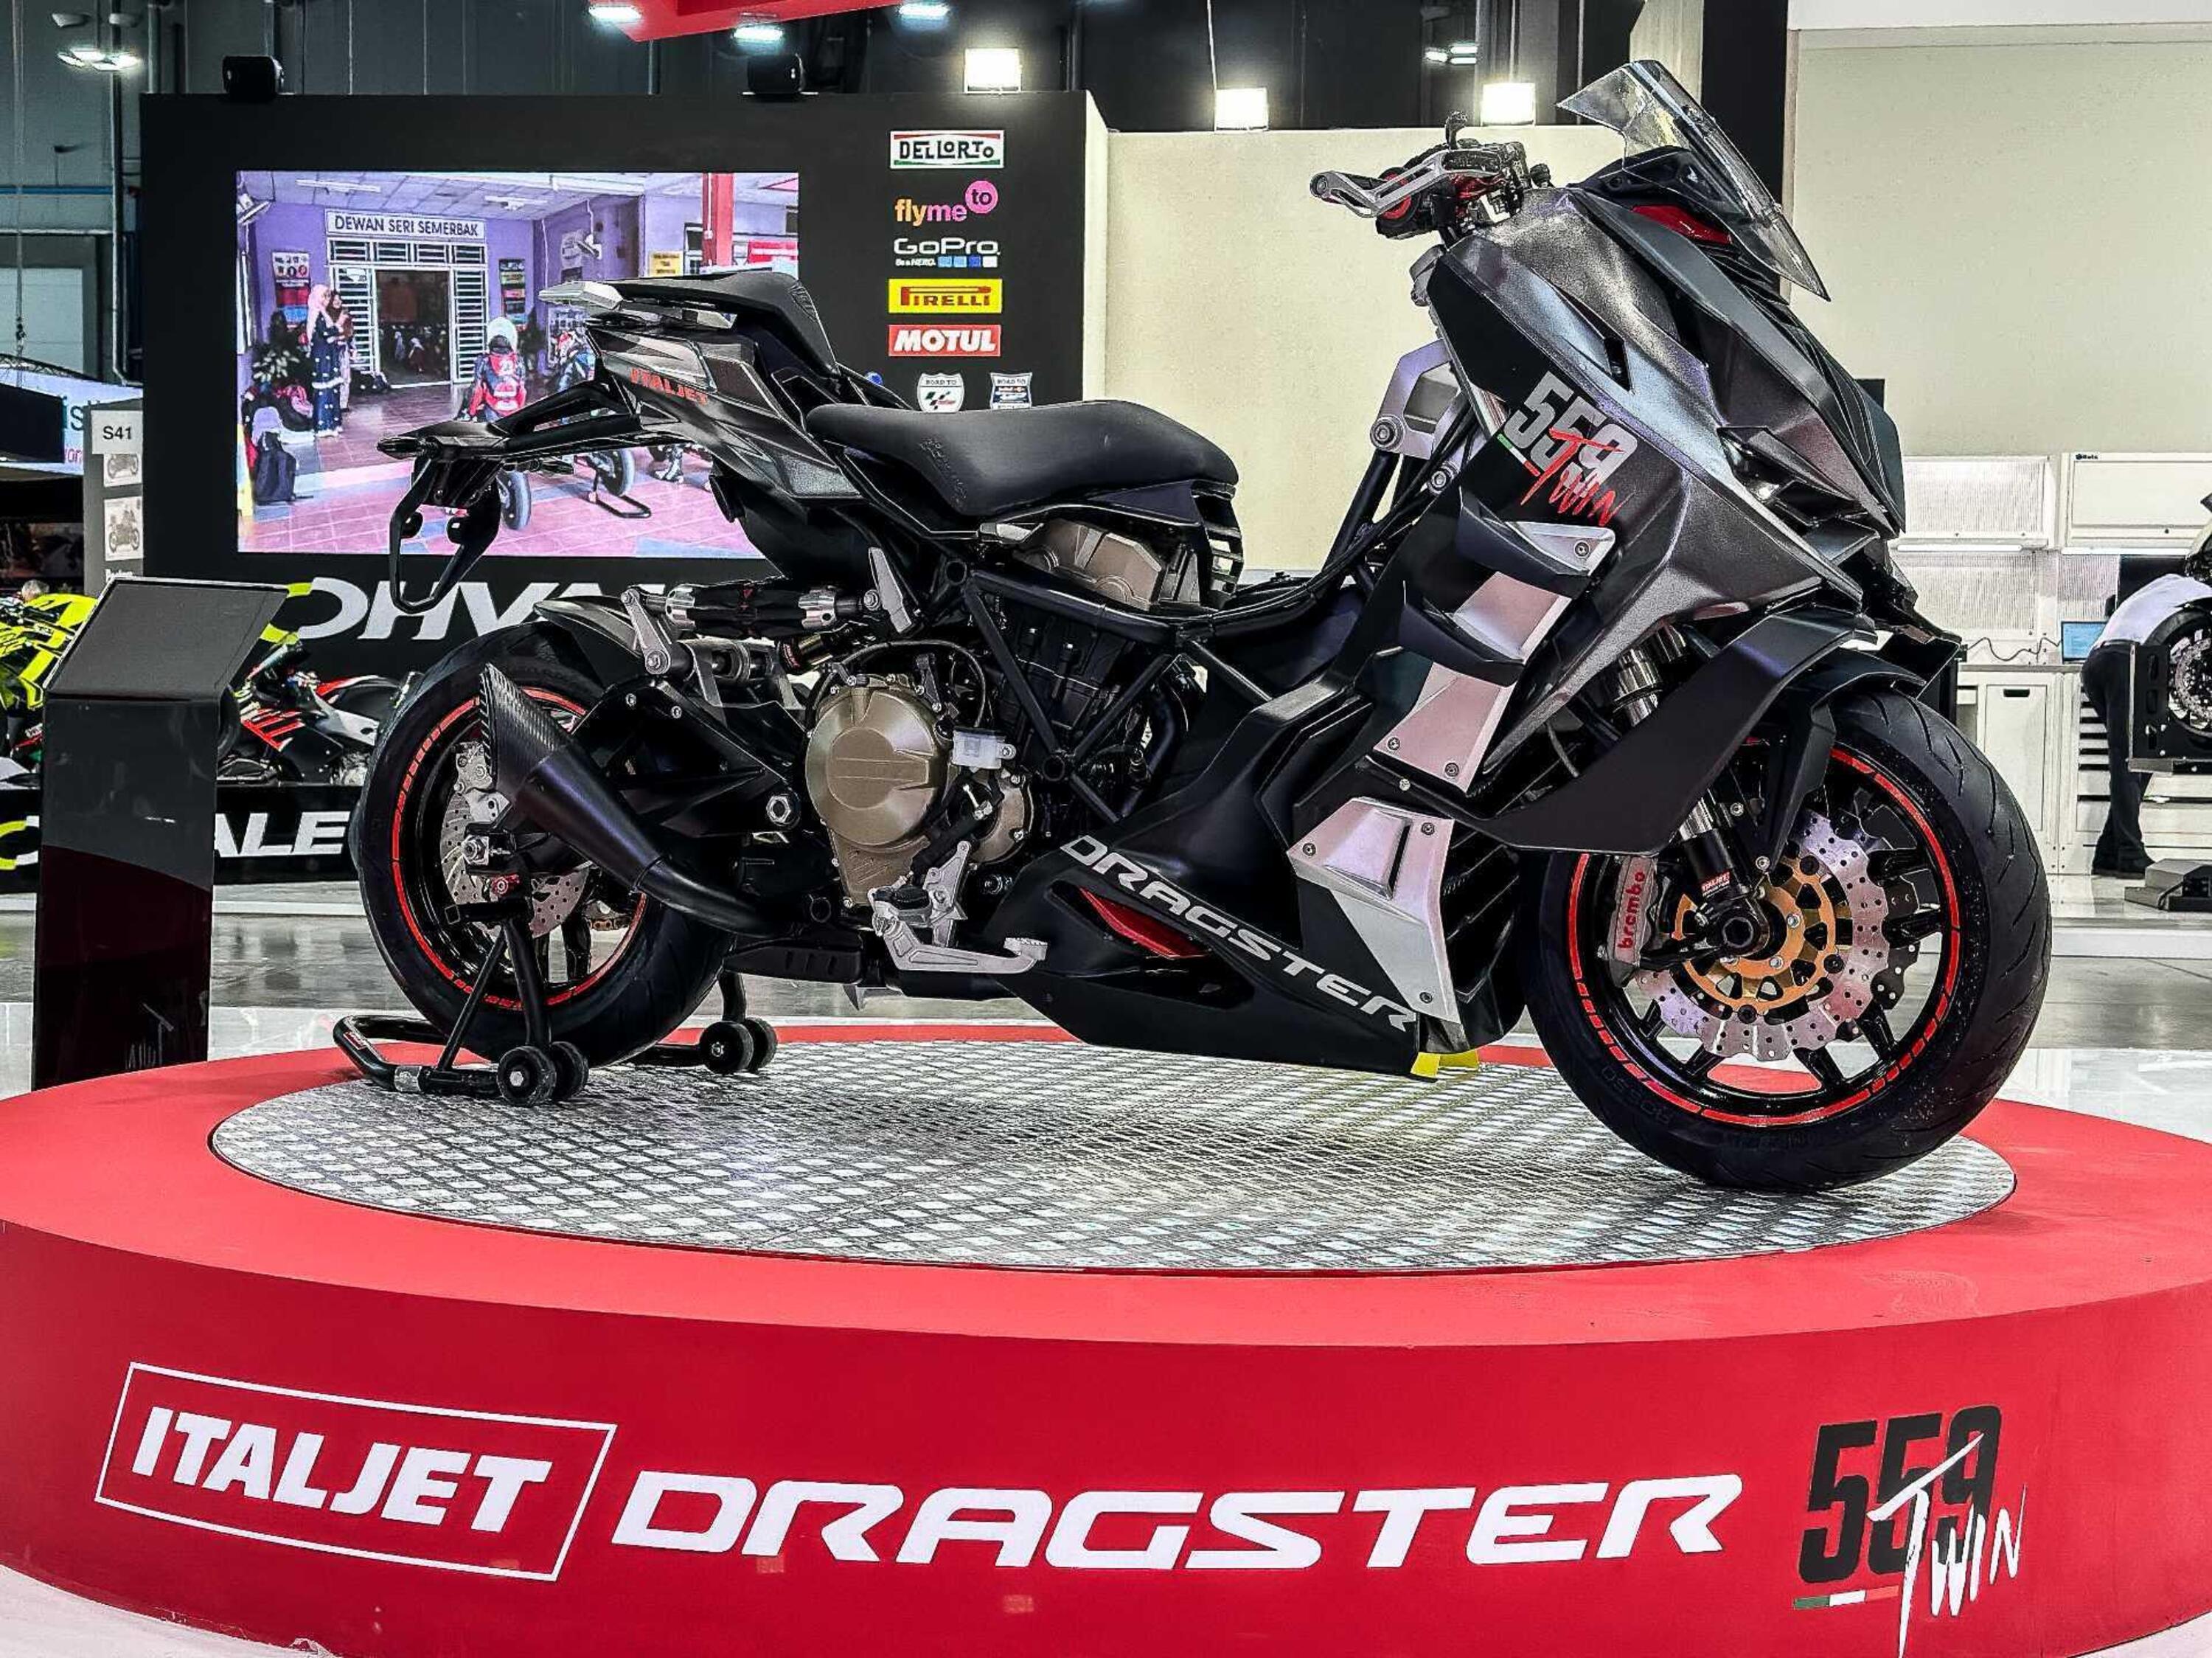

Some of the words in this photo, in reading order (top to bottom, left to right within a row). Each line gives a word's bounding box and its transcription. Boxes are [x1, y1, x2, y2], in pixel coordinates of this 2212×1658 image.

[334, 215, 384, 232] DEWAN
[388, 219, 414, 234] SERI
[417, 221, 479, 237] SEMERBAK
[894, 198, 967, 226] flyme
[971, 188, 992, 205] to
[900, 285, 992, 306] PIRELLI
[893, 329, 996, 353] MOTUL
[102, 426, 132, 440] S41
[1503, 370, 1638, 499] 559
[1060, 834, 1418, 1033] DRAGSTER
[1617, 871, 1646, 948] brembo
[131, 1406, 553, 1533] ITALJET
[1798, 1404, 2003, 1584] 559
[611, 1471, 1743, 1569] DRAGSTER
